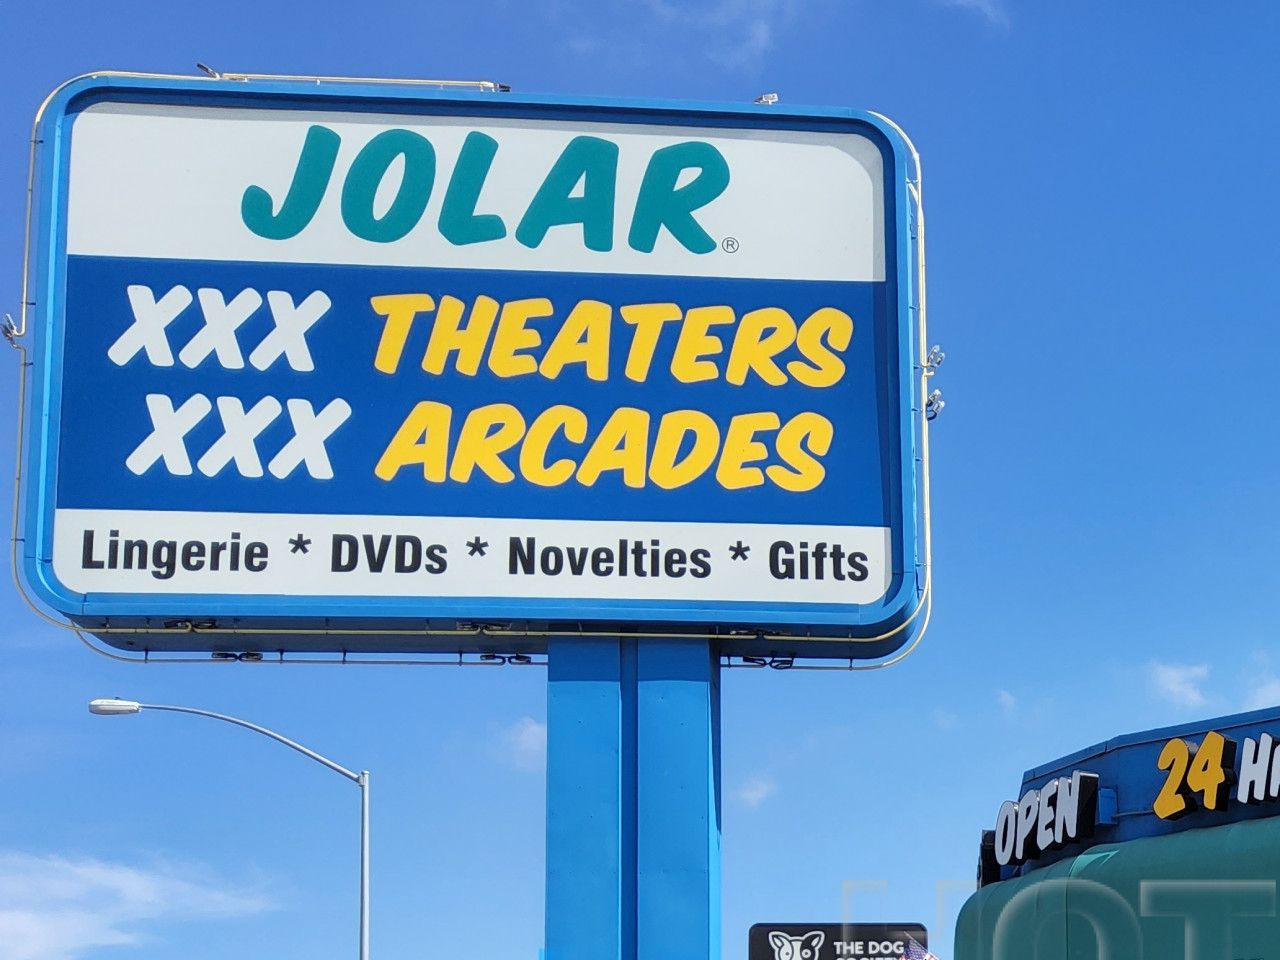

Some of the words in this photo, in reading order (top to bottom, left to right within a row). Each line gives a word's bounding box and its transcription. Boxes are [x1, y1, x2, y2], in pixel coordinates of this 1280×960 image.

[108, 284, 332, 372] XXX
[370, 293, 854, 388] THEATERS
[126, 394, 351, 480] XXX
[375, 401, 833, 492] ARCADES
[81, 530, 269, 581] Lingerie
[331, 534, 448, 575] DVDs
[508, 536, 712, 580] Novelties
[769, 541, 869, 583] Gifts
[994, 770, 1081, 866] OPEN
[1153, 731, 1226, 819] 24
[833, 941, 864, 954] THE
[868, 941, 904, 955] DOG
